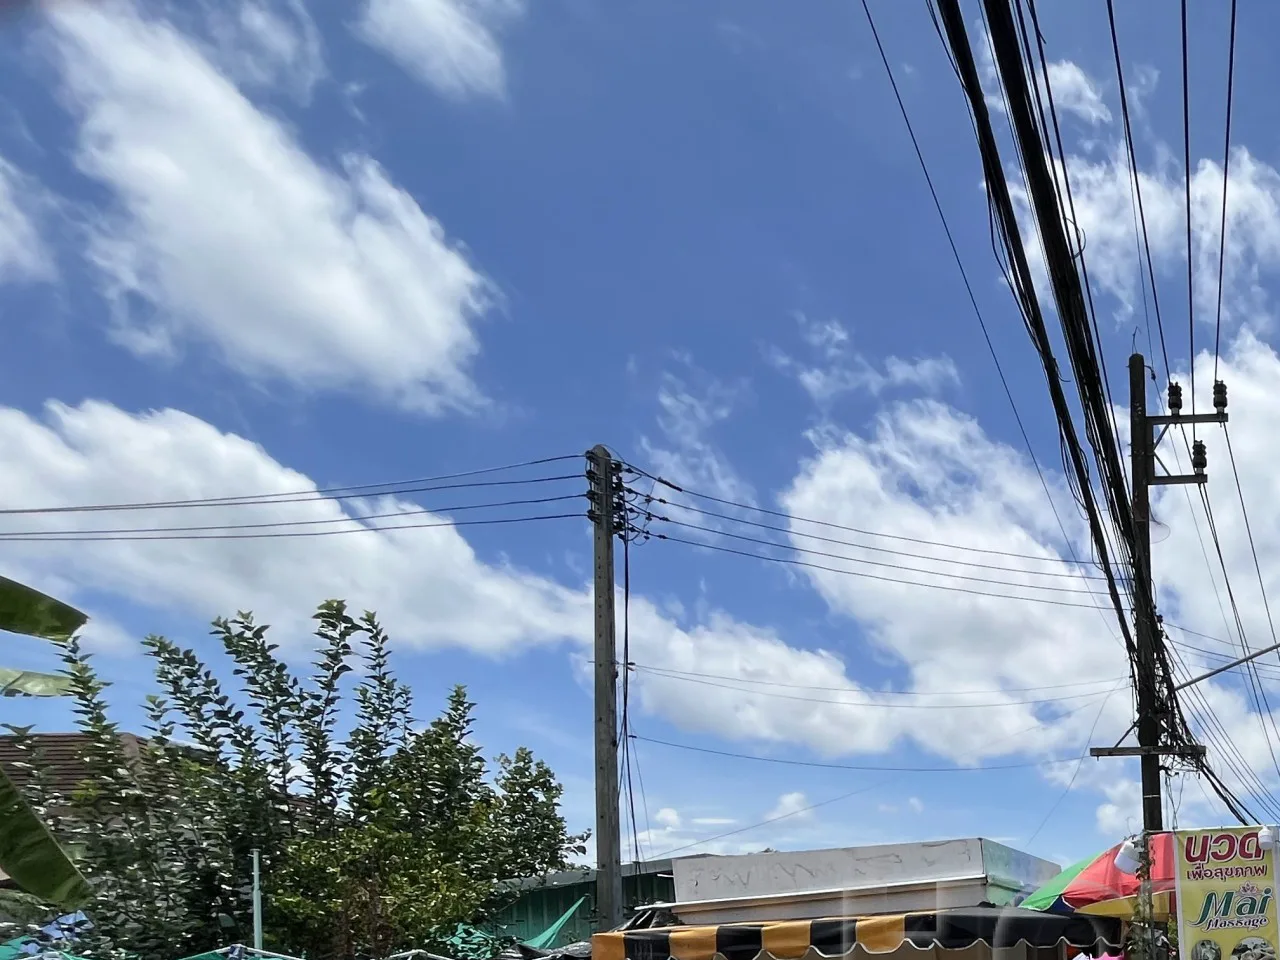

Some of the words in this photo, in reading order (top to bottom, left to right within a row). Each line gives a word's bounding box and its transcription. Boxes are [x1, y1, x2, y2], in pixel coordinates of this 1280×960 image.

[1185, 832, 1265, 863] นวด
[1187, 863, 1267, 881] เพื่อสุขภาพ
[1189, 888, 1272, 925] Mai
[1207, 917, 1267, 930] Massage
